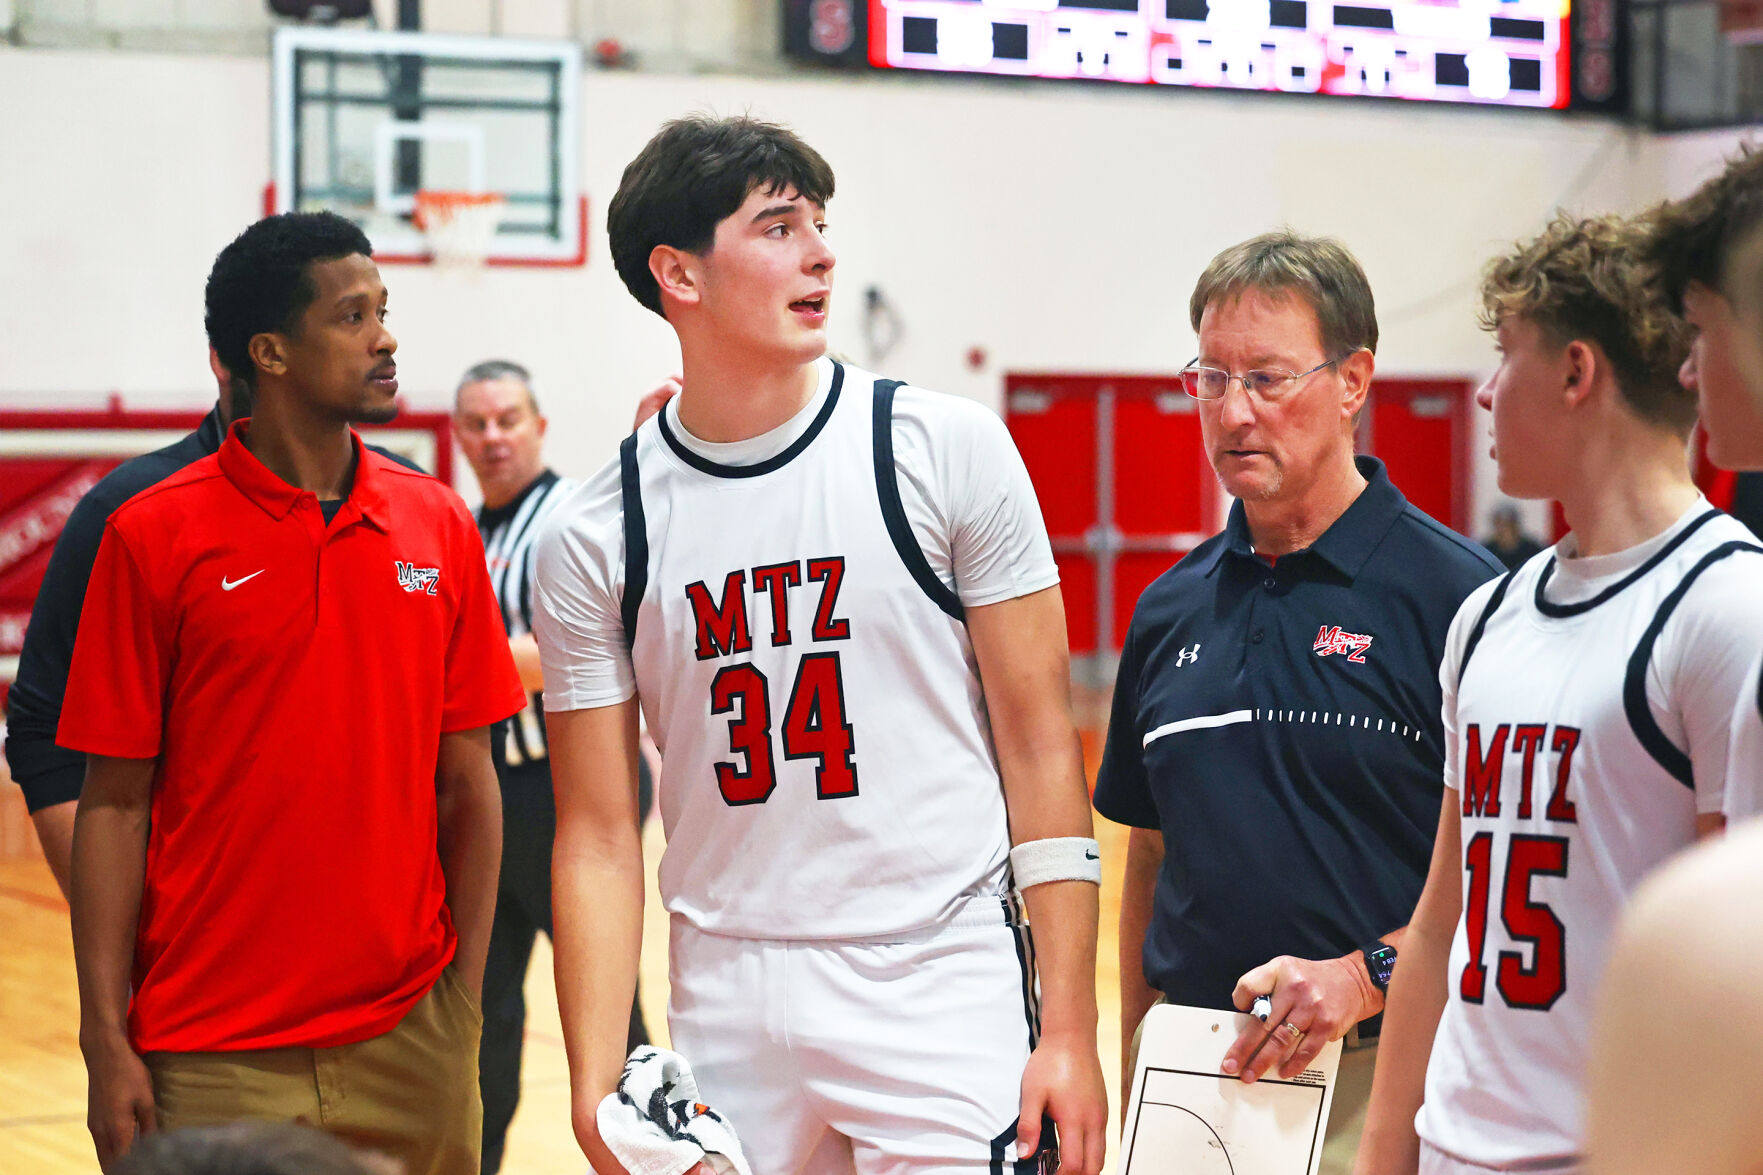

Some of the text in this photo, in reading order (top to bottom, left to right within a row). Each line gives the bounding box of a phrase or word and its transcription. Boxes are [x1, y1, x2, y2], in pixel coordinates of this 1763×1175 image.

[685, 556, 851, 661] MTZ
[711, 651, 859, 806] 34
[1463, 723, 1581, 823] MTZ
[1460, 831, 1569, 1012] 15
